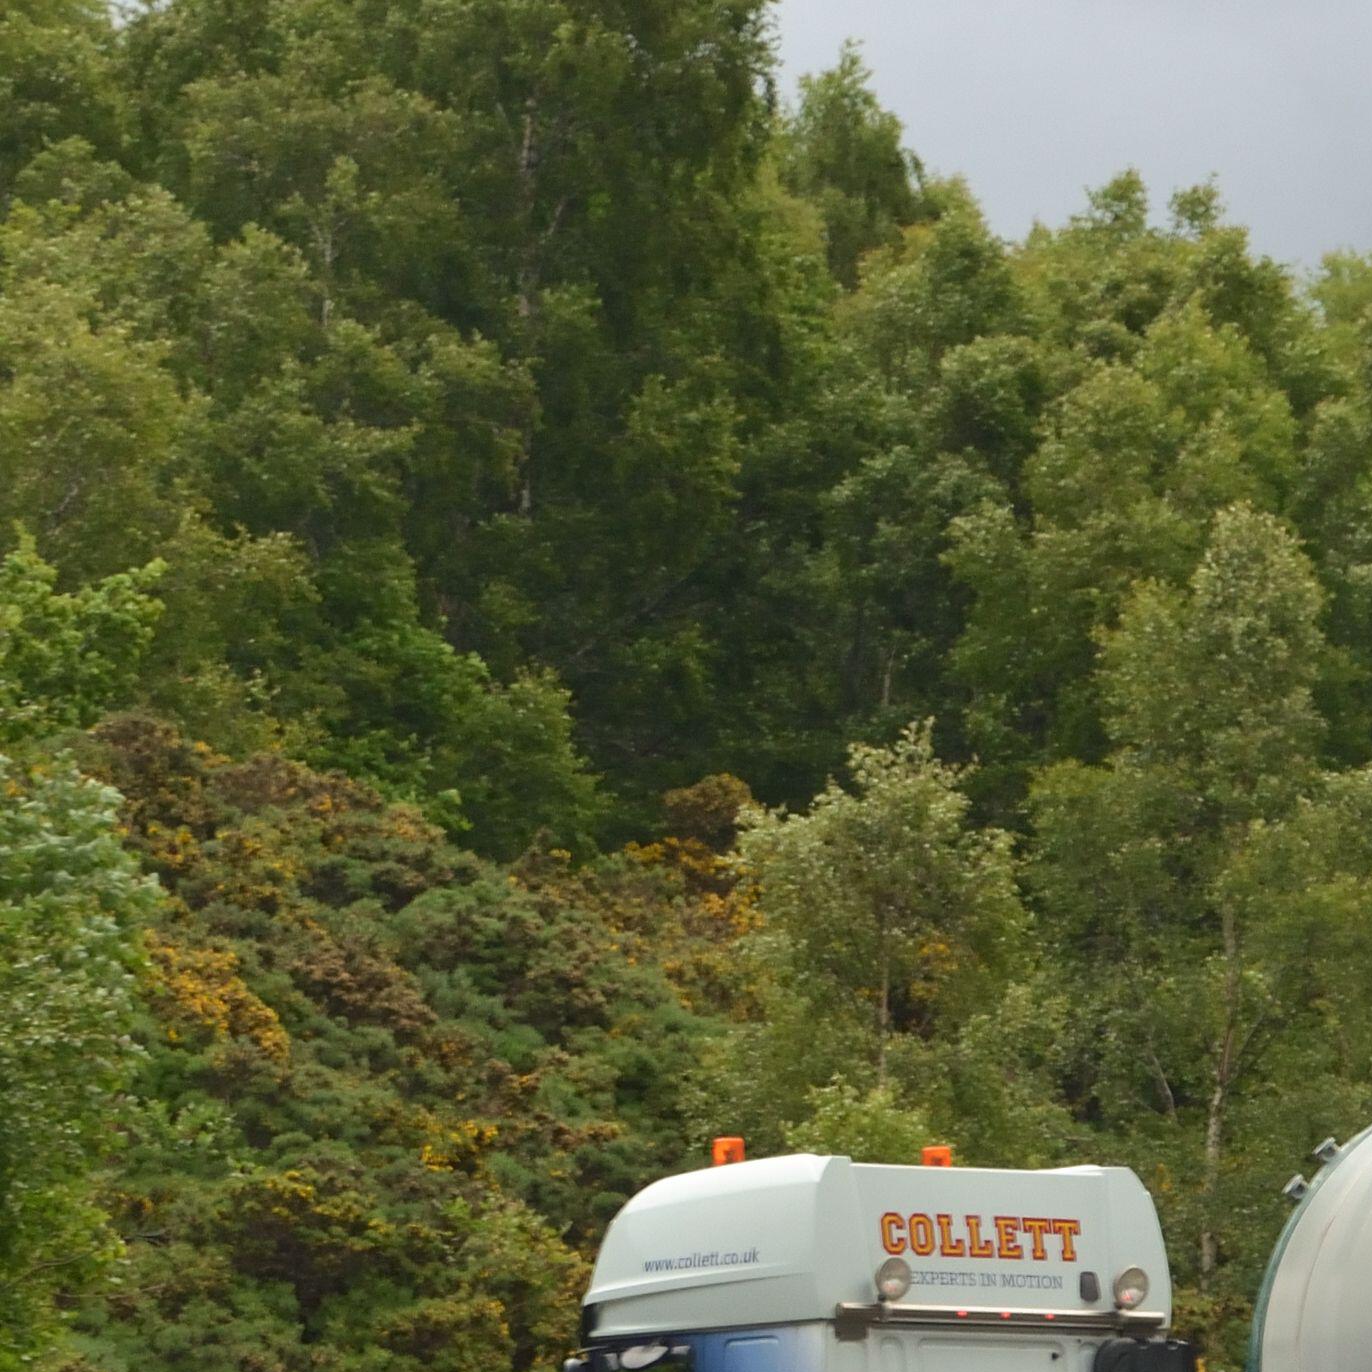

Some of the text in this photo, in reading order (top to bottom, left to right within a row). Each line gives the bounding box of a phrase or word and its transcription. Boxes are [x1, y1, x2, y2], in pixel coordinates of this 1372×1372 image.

[880, 1212, 1081, 1262] COLLETT
[643, 1247, 761, 1273] www.collett.co.uk
[911, 1270, 1064, 1290] EXPERTS IN MOTION
